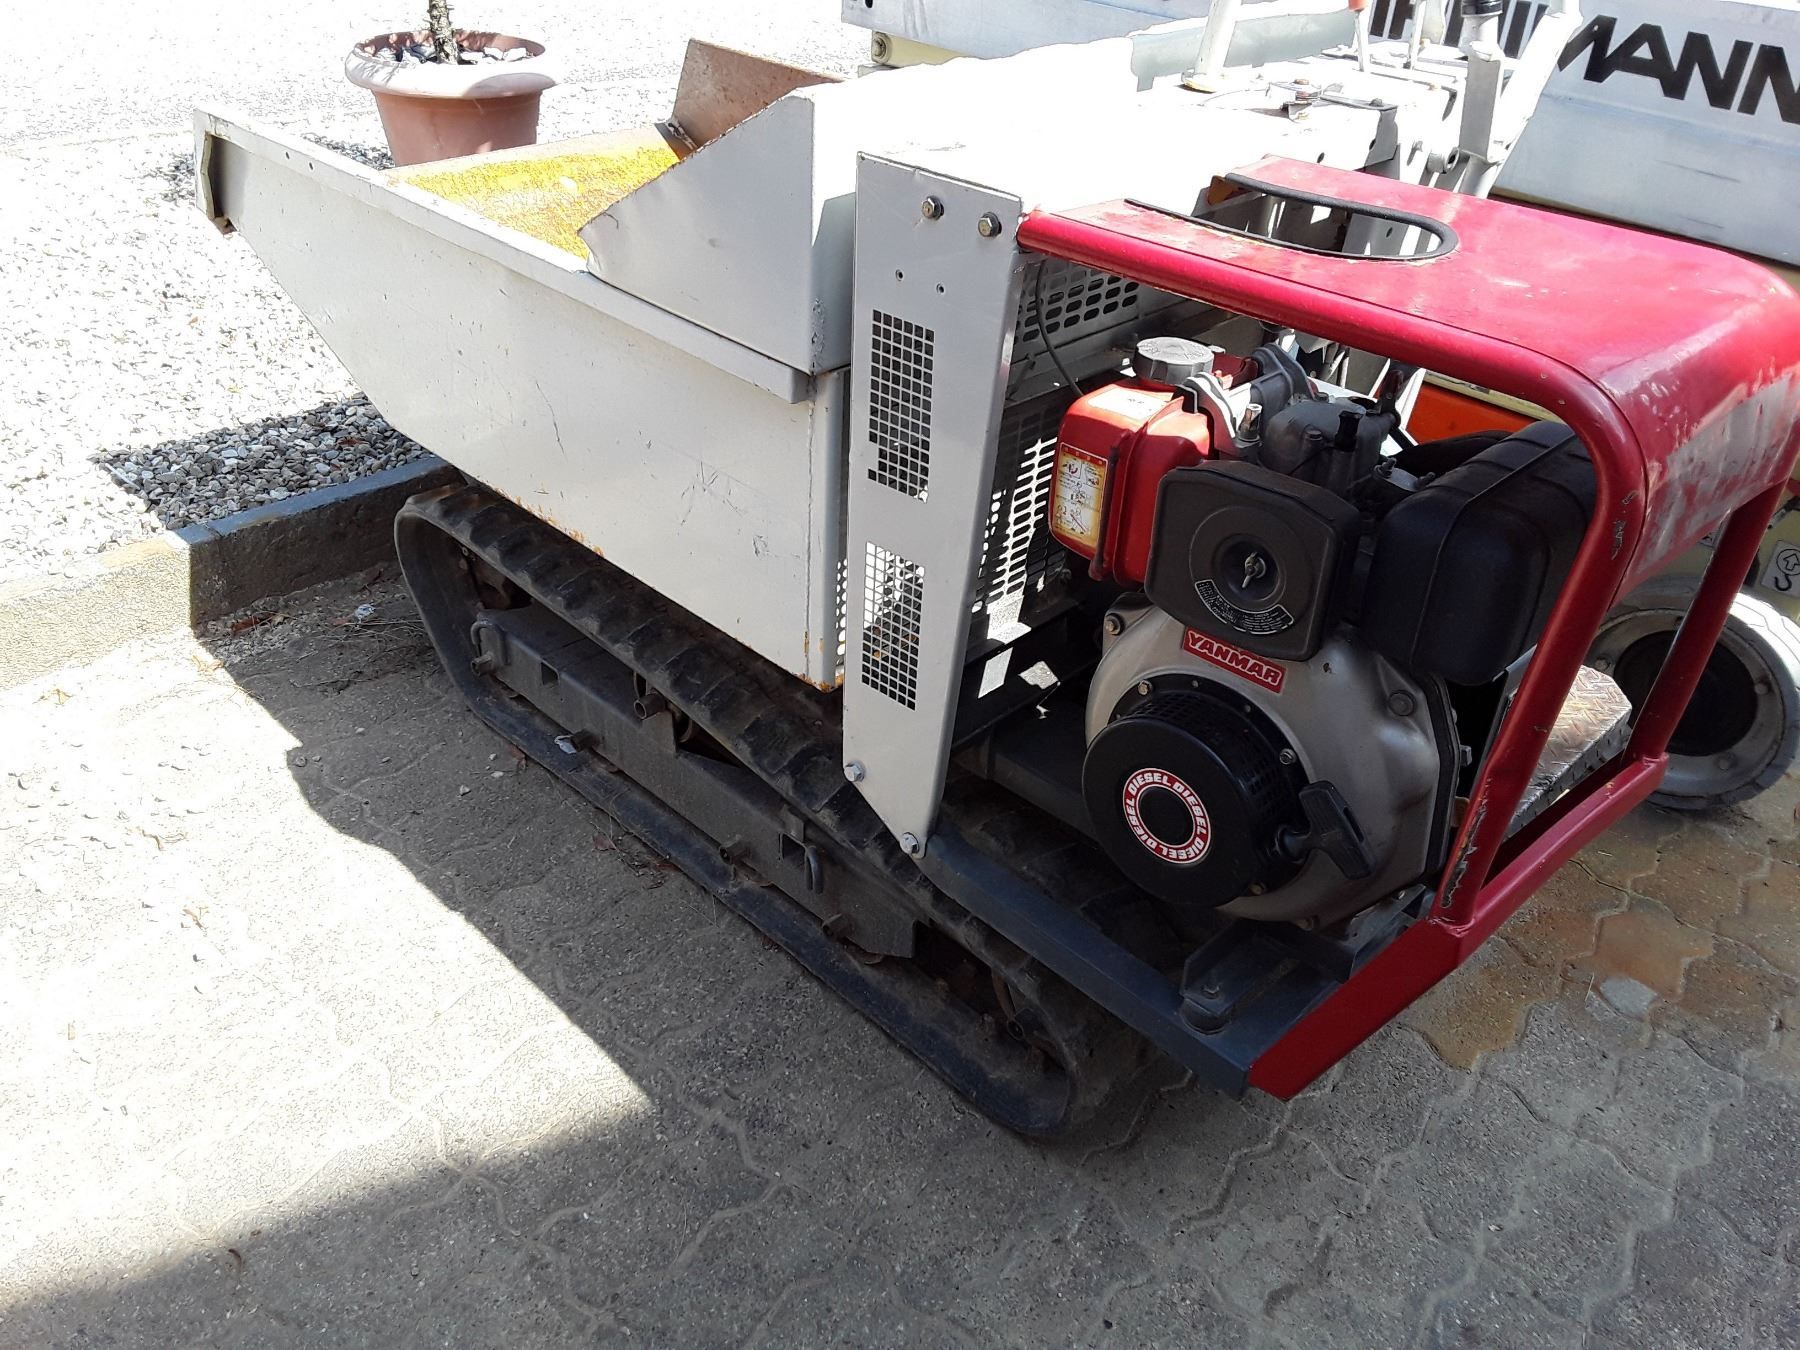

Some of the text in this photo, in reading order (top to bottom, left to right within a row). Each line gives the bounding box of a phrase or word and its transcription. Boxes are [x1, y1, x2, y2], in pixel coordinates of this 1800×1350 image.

[1188, 630, 1282, 686] YANMAR
[1126, 772, 1207, 860] DIESEL DIESEL DIESEL DIESEL
